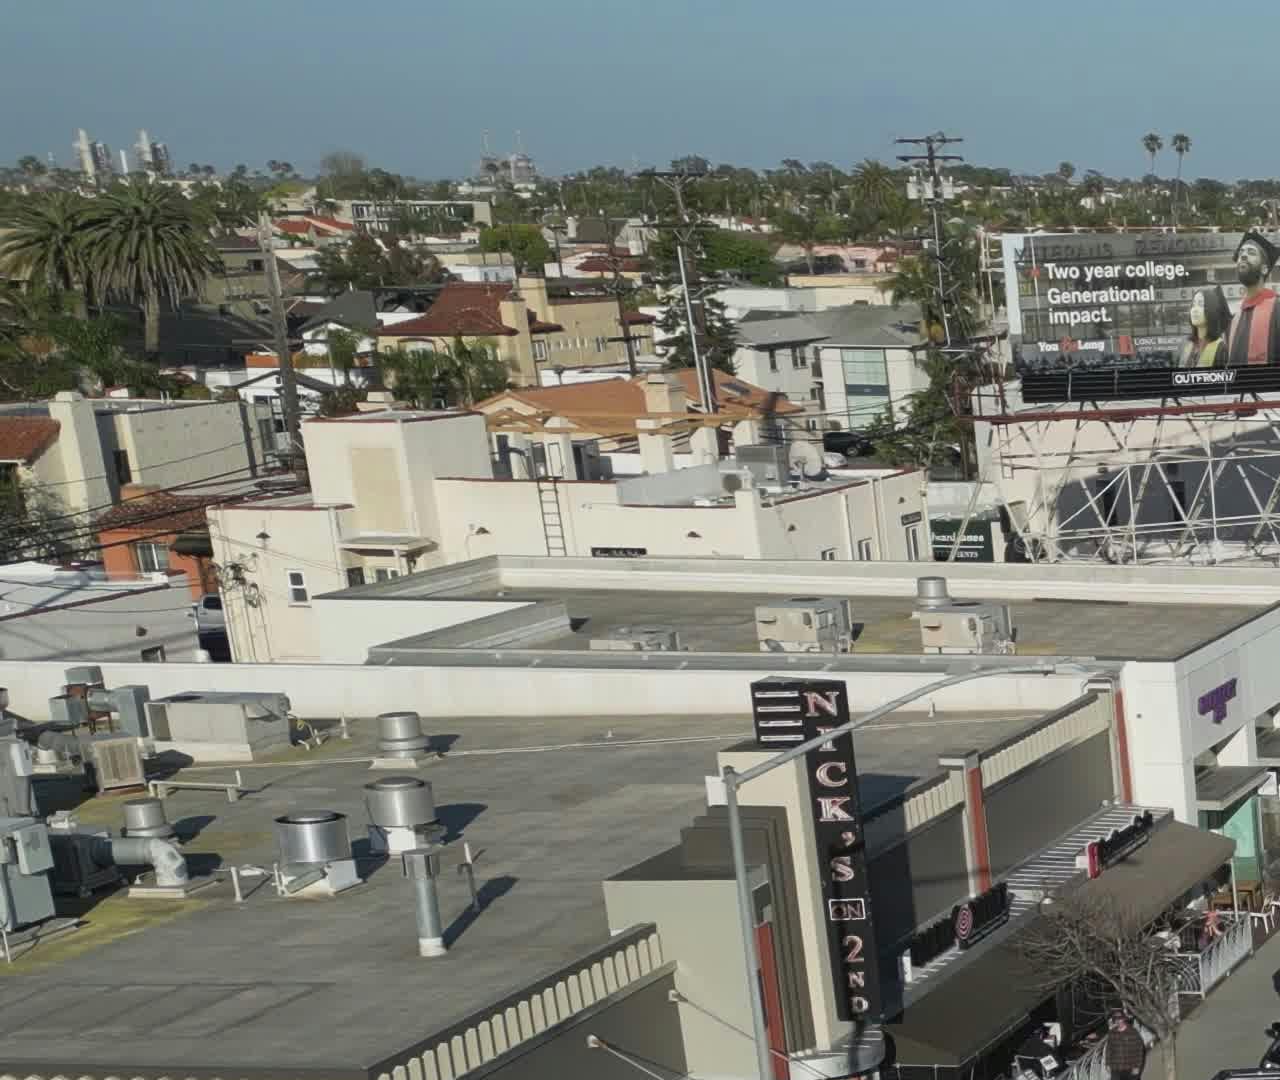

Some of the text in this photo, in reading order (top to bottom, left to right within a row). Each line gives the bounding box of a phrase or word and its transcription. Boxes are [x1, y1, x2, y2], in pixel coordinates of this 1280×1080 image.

[1044, 261, 1190, 282] Two year college.
[1047, 286, 1155, 304] Generational
[1049, 307, 1112, 326] impact.
[803, 691, 856, 882] NICK'S
[844, 935, 870, 1013] 2ND
